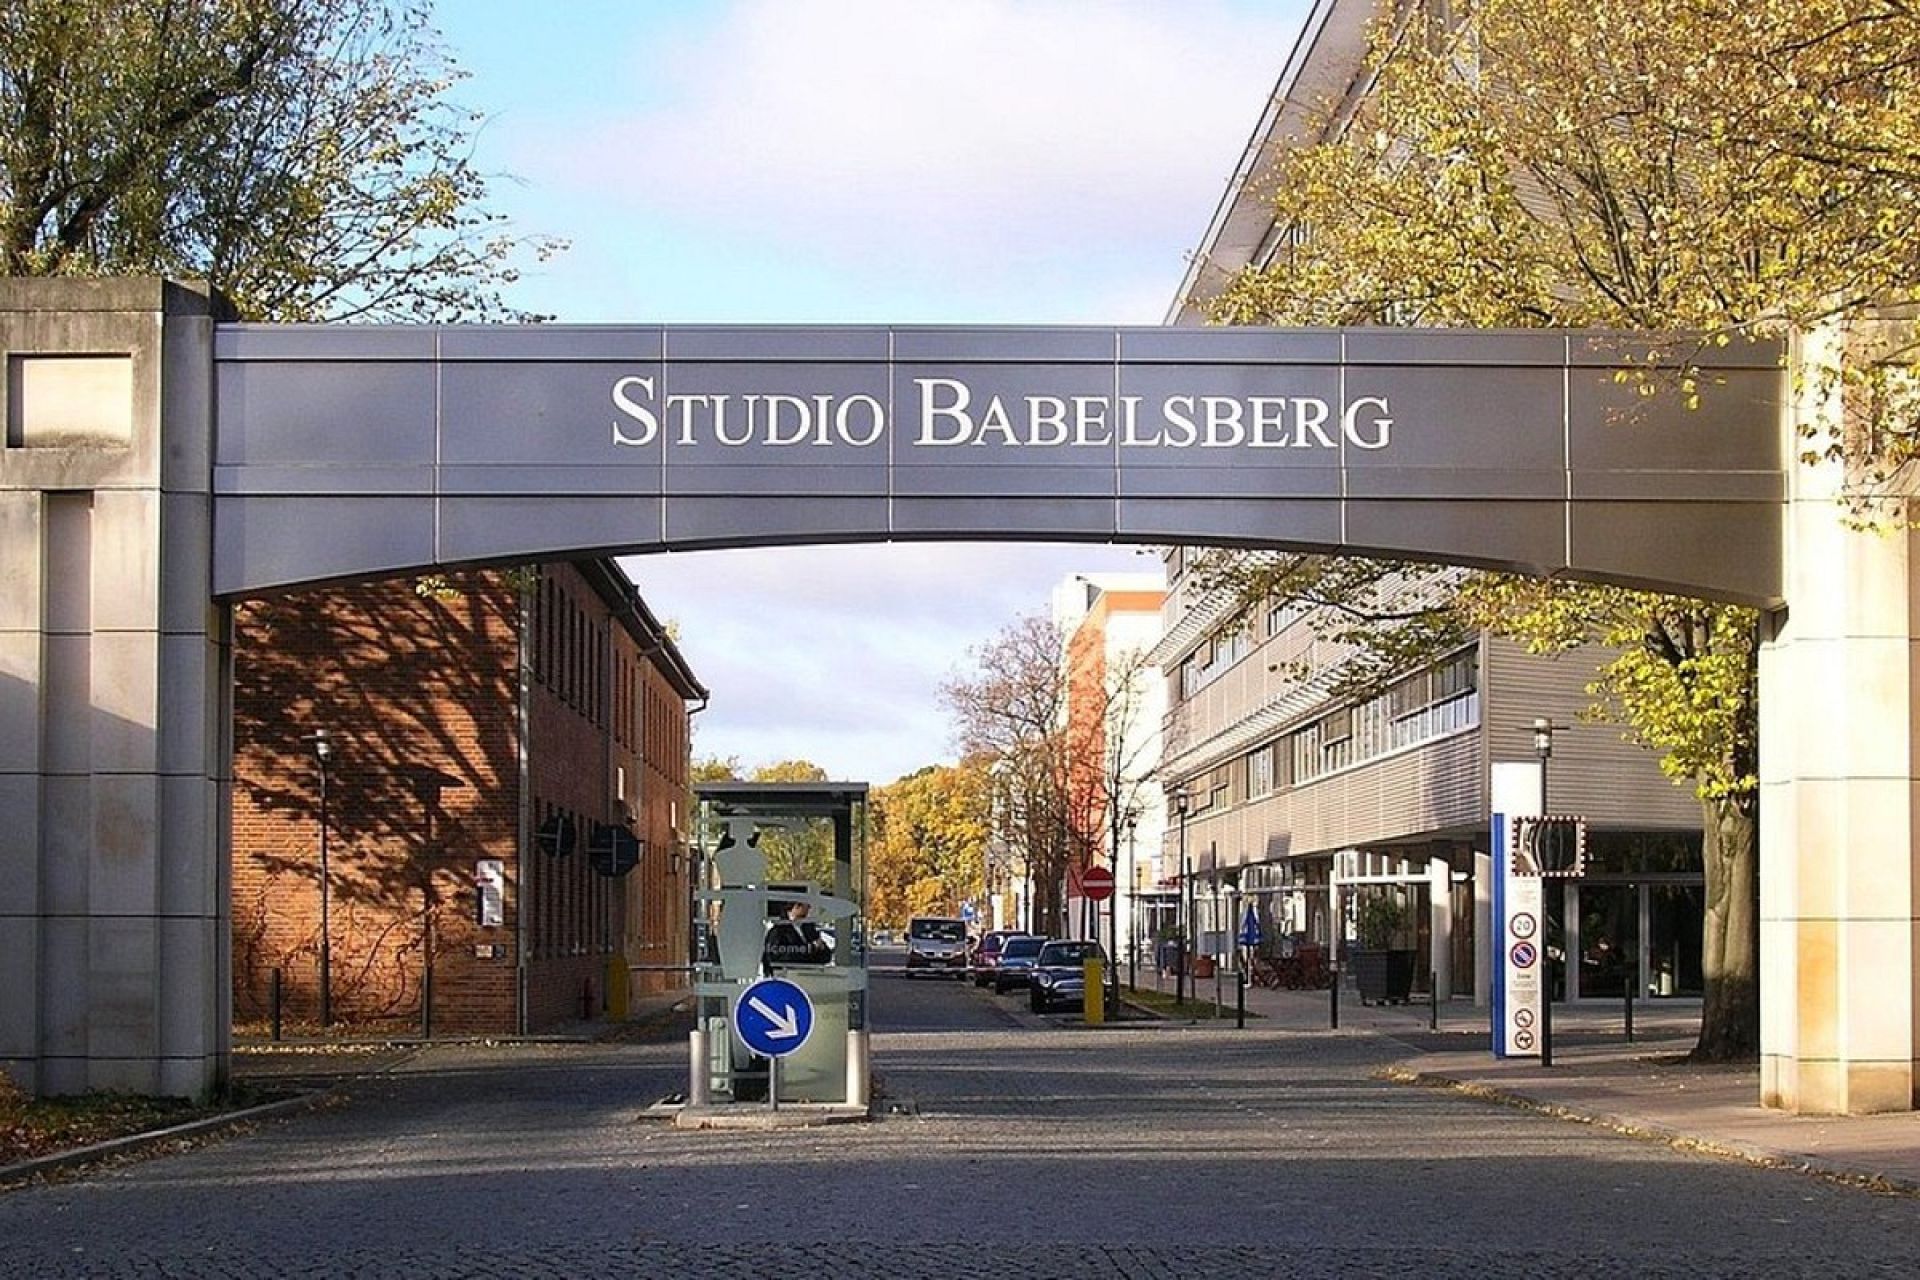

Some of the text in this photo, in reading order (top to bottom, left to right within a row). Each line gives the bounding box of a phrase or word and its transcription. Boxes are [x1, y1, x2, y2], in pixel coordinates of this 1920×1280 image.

[611, 376, 1394, 448] STUDIO BABELSBERG
[1516, 920, 1530, 931] 20
